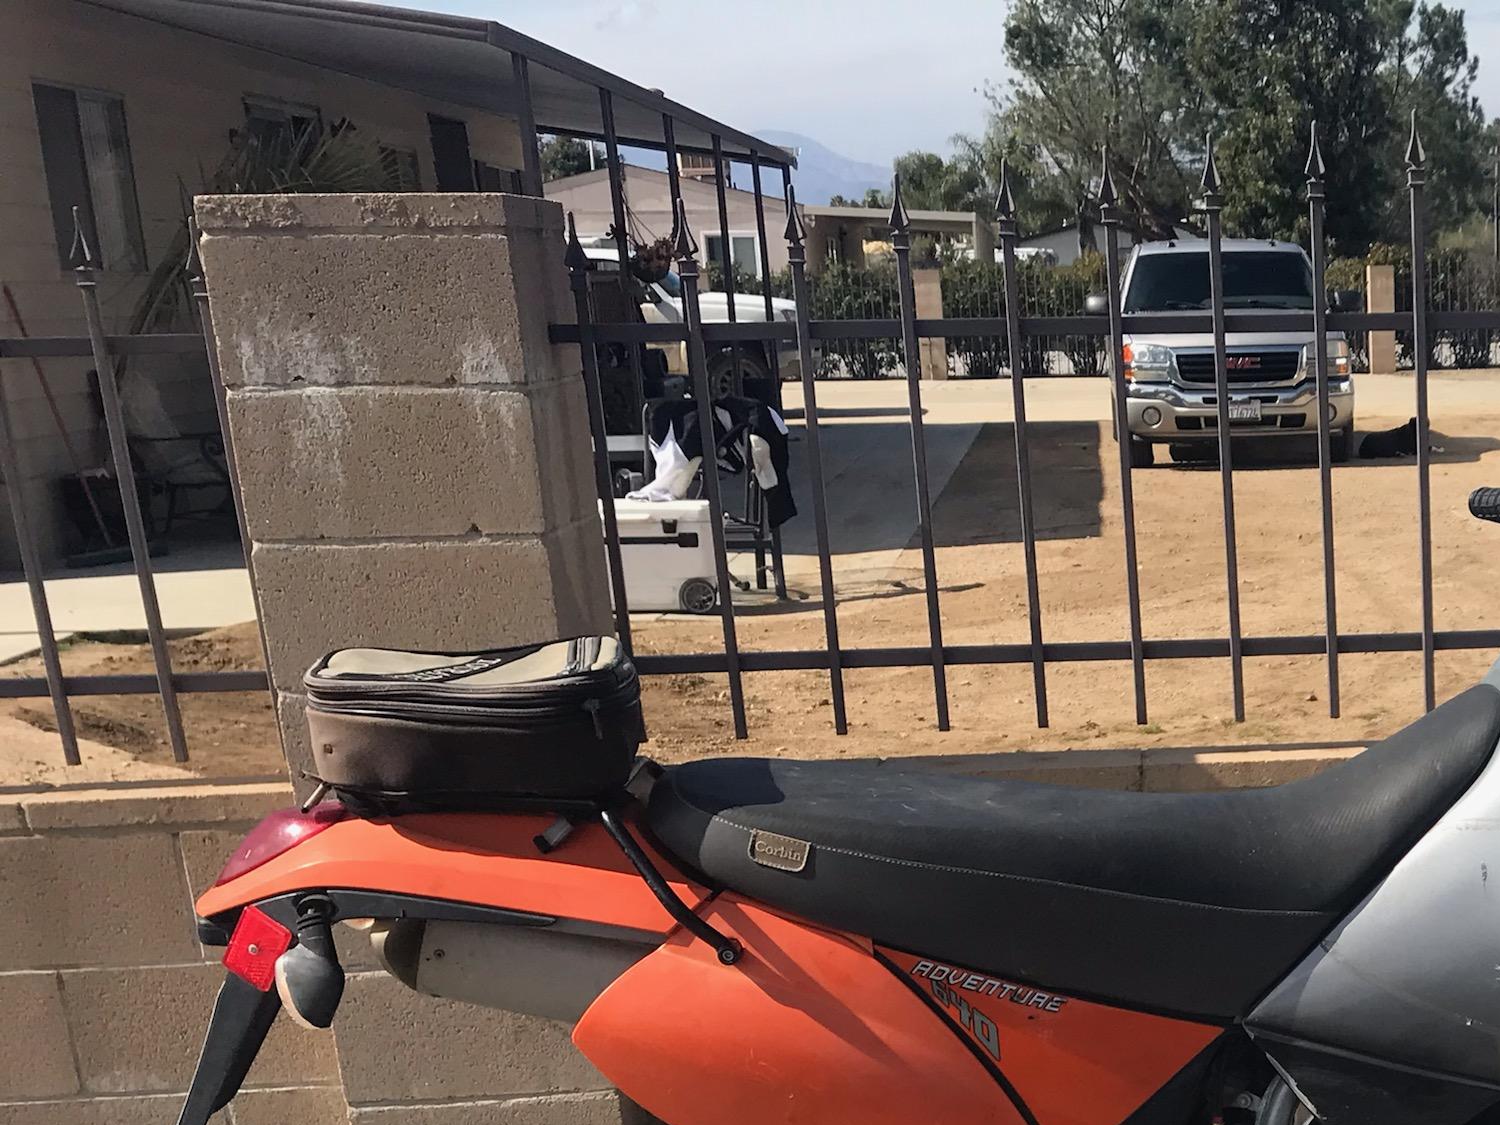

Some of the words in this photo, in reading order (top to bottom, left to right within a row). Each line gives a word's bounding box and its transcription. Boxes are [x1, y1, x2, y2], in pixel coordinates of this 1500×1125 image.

[1226, 357, 1261, 369] MC
[754, 840, 801, 861] Corbin
[911, 959, 1067, 1013] ADVENTURE
[929, 980, 1001, 1061] 640
